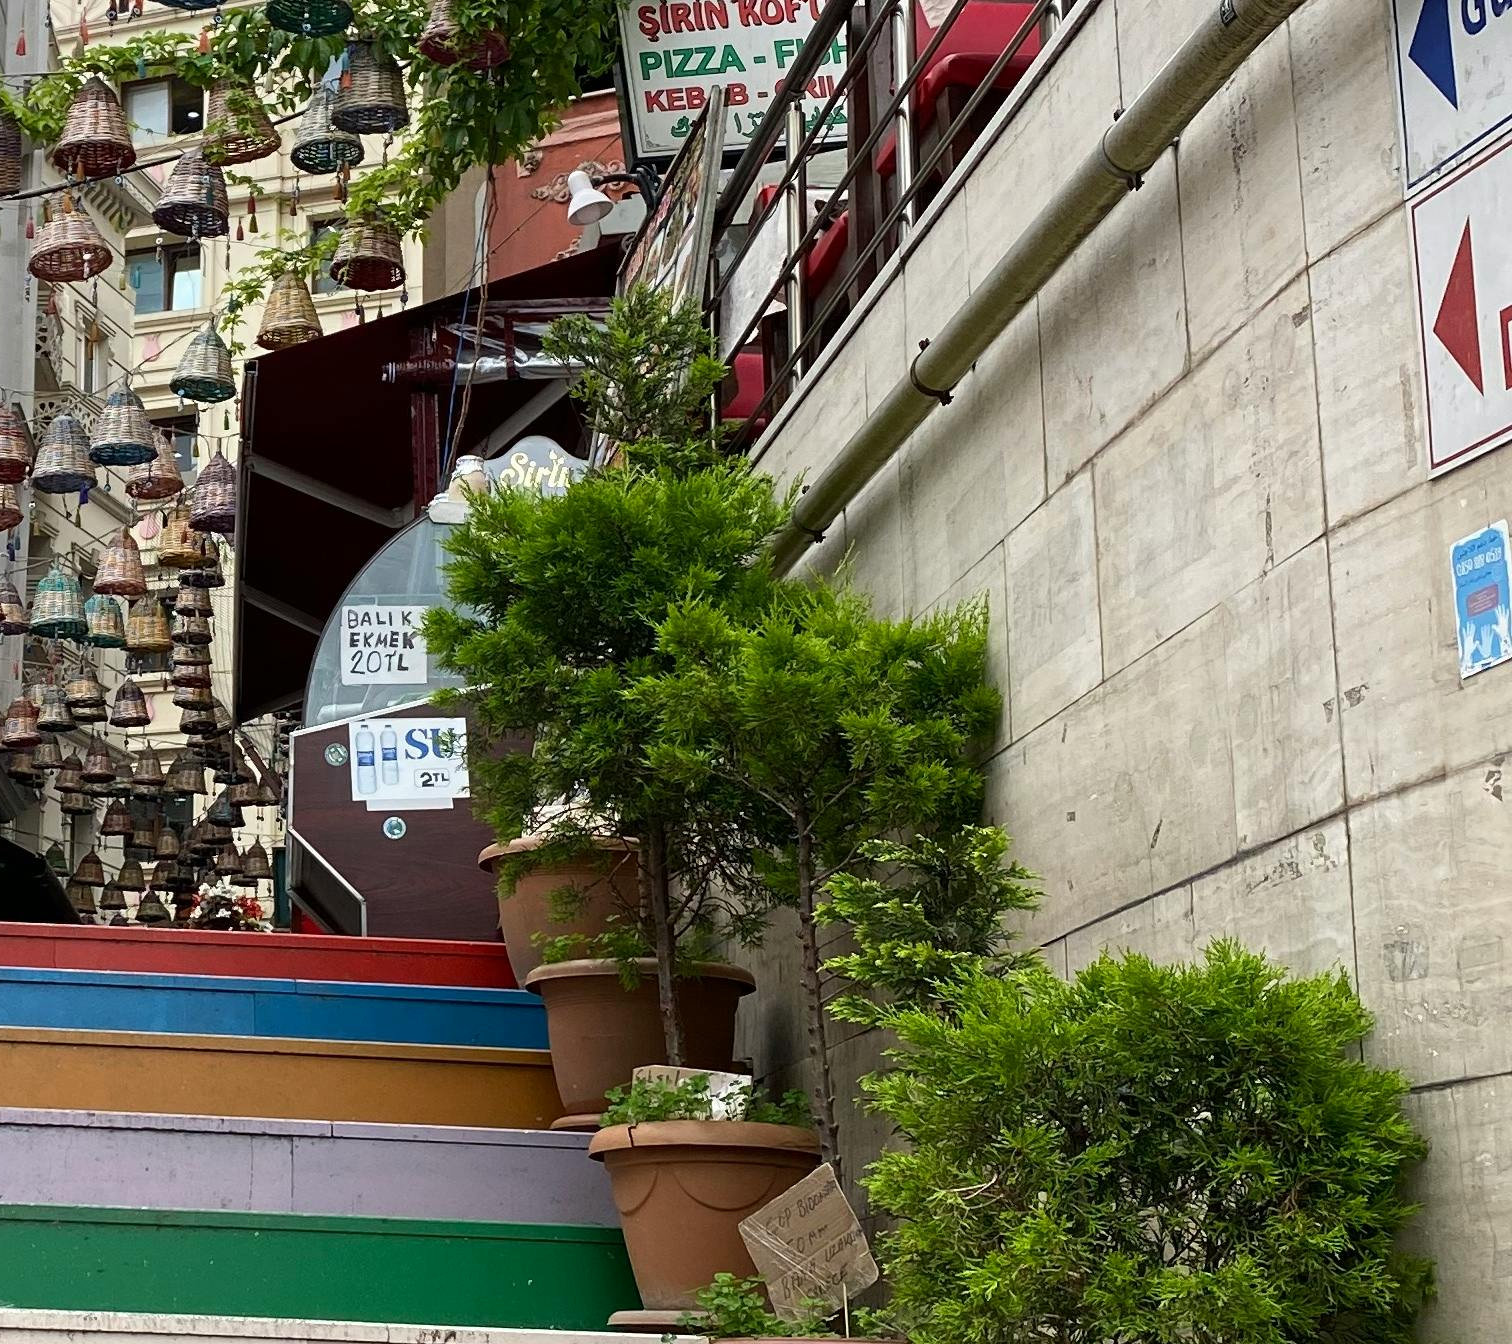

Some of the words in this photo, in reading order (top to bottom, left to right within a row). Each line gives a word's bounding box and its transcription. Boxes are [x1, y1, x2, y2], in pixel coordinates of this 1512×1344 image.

[639, 44, 746, 80] PIZZA
[644, 83, 749, 113] KEBB
[349, 631, 420, 649] EKMEK
[405, 727, 455, 760] SU
